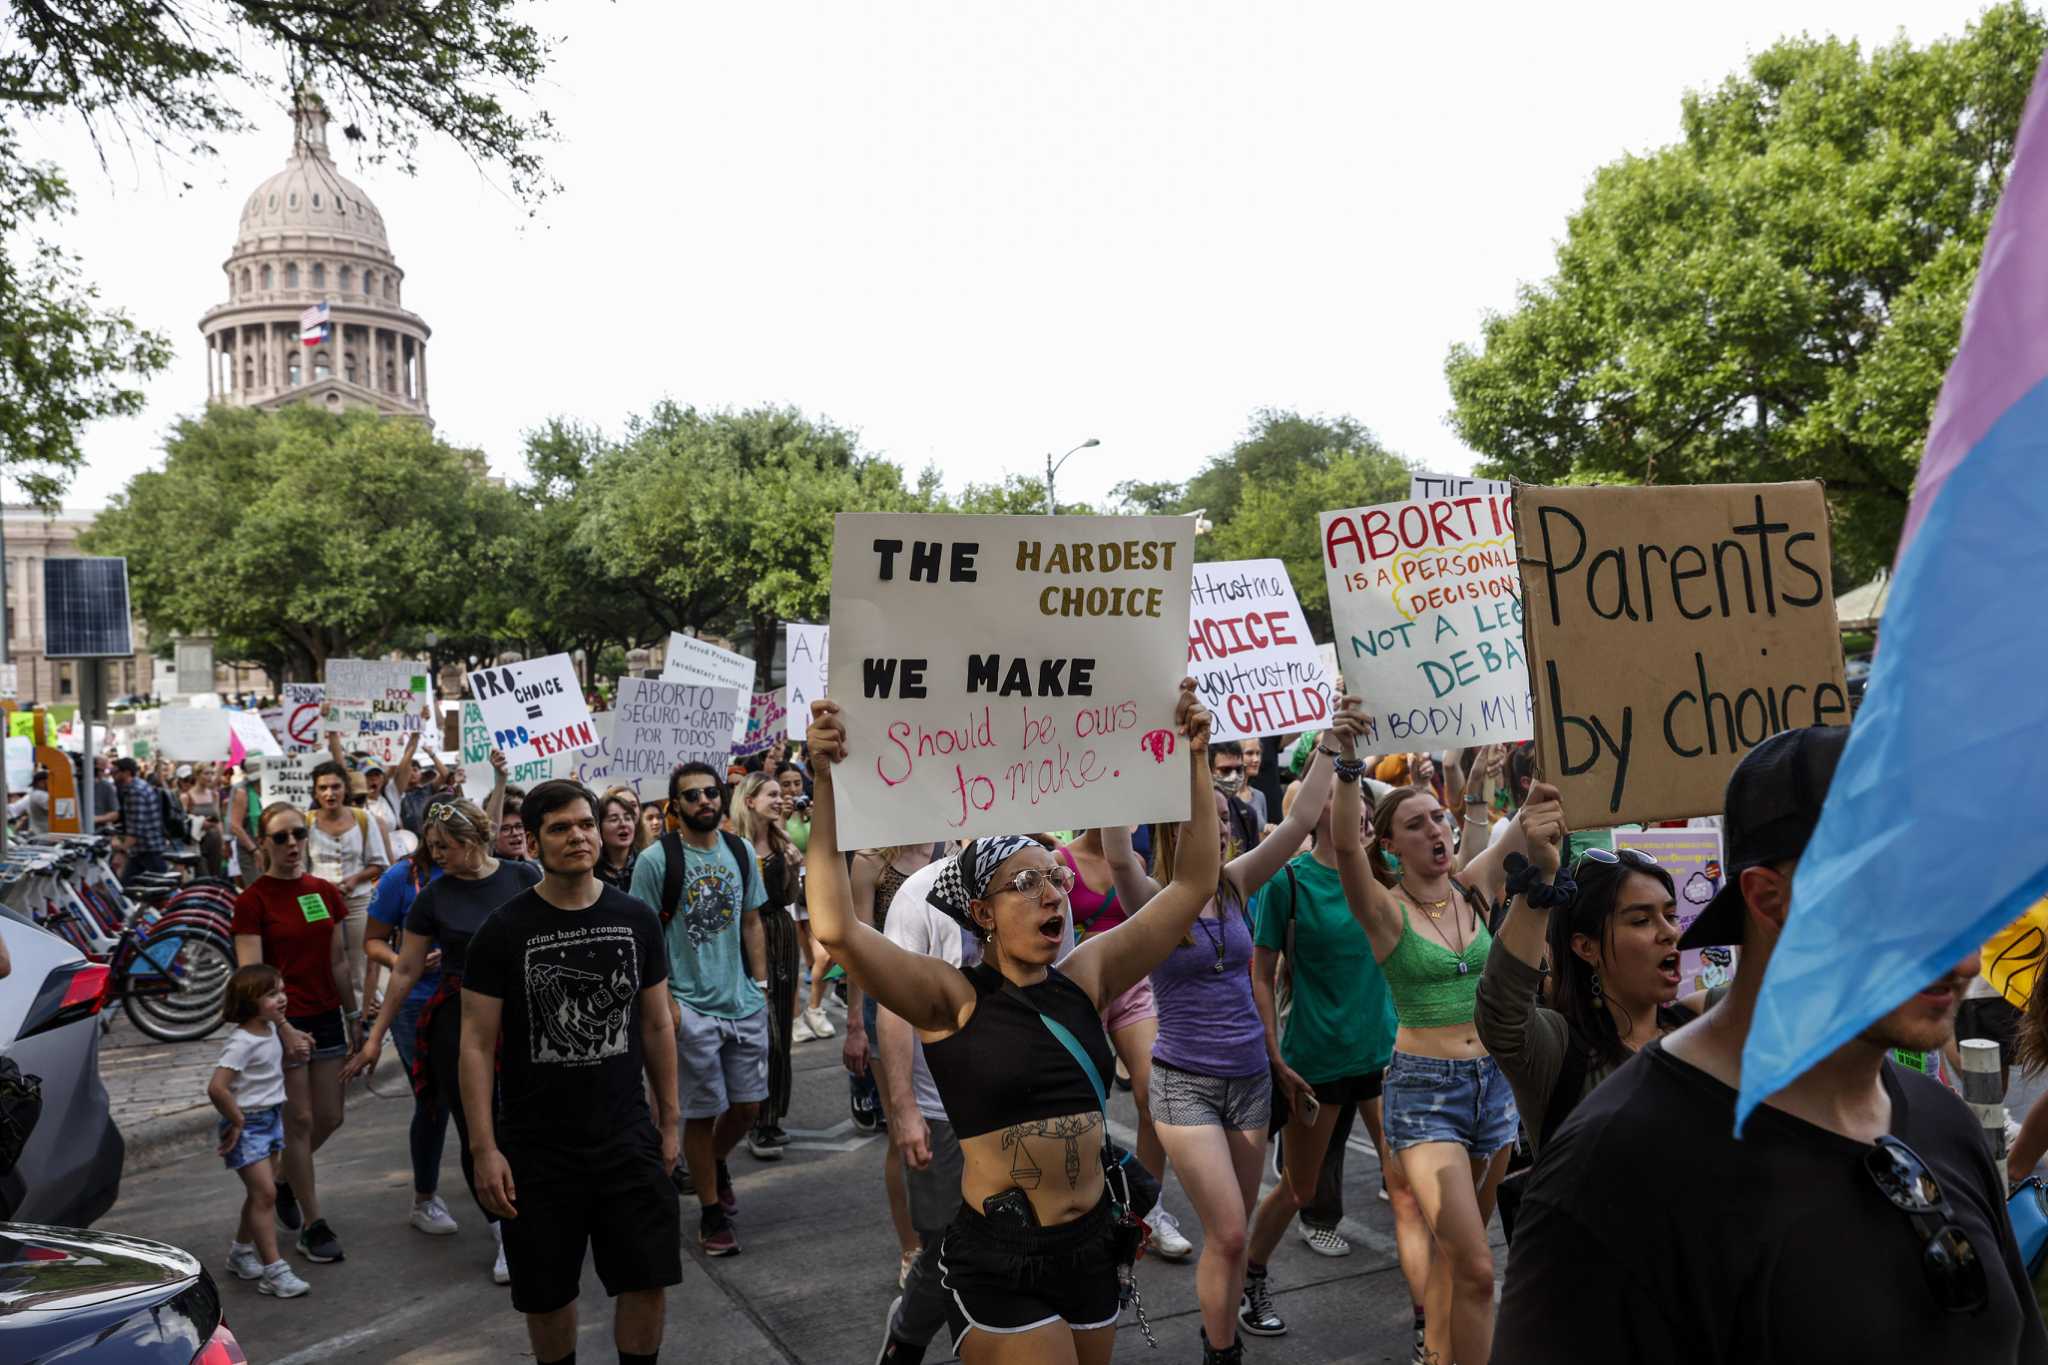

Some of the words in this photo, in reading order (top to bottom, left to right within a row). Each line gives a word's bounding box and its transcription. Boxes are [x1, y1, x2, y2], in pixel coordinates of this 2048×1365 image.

[873, 539, 980, 584] THE
[1015, 541, 1177, 574] HARDEST
[1344, 573, 1369, 593] IS
[1377, 568, 1391, 587] A
[1402, 548, 1517, 585] PERSONAL
[1538, 494, 1824, 626] Parents
[1039, 586, 1163, 618] CHOICE
[1206, 573, 1252, 606] trust
[1254, 576, 1284, 600] me
[1410, 574, 1514, 615] DECISION
[1187, 611, 1297, 663] HOICE
[1351, 621, 1416, 659] NOT
[1435, 614, 1458, 644] A
[863, 658, 928, 699] WE
[966, 654, 1096, 697] MAKE
[1195, 669, 1234, 706] you
[1231, 662, 1285, 694] trust
[1287, 662, 1323, 683] me
[1417, 634, 1524, 699] DEBA
[372, 699, 409, 714] BLACK
[514, 677, 564, 704] CHOICE
[634, 680, 714, 710] ABORTO
[1209, 709, 1226, 736] a
[1227, 681, 1333, 734] CHILD?
[622, 703, 680, 725] SEGURO
[690, 709, 736, 732] GRATIS
[1481, 695, 1518, 730] MY
[530, 721, 593, 758] TEXAN
[635, 727, 662, 745] POR
[671, 728, 716, 748] TODOS
[877, 706, 998, 786] Should
[1023, 705, 1056, 750] be
[1076, 701, 1137, 738] ours
[1546, 659, 1633, 815] by
[1663, 648, 1847, 759] choice
[266, 760, 303, 770] HUMAN
[464, 743, 492, 764] NOT
[611, 747, 665, 775] AHORA
[269, 784, 313, 796] SHOULD
[947, 764, 995, 828] to
[527, 934, 555, 946] crime
[557, 927, 588, 940] based
[590, 925, 633, 936] economy
